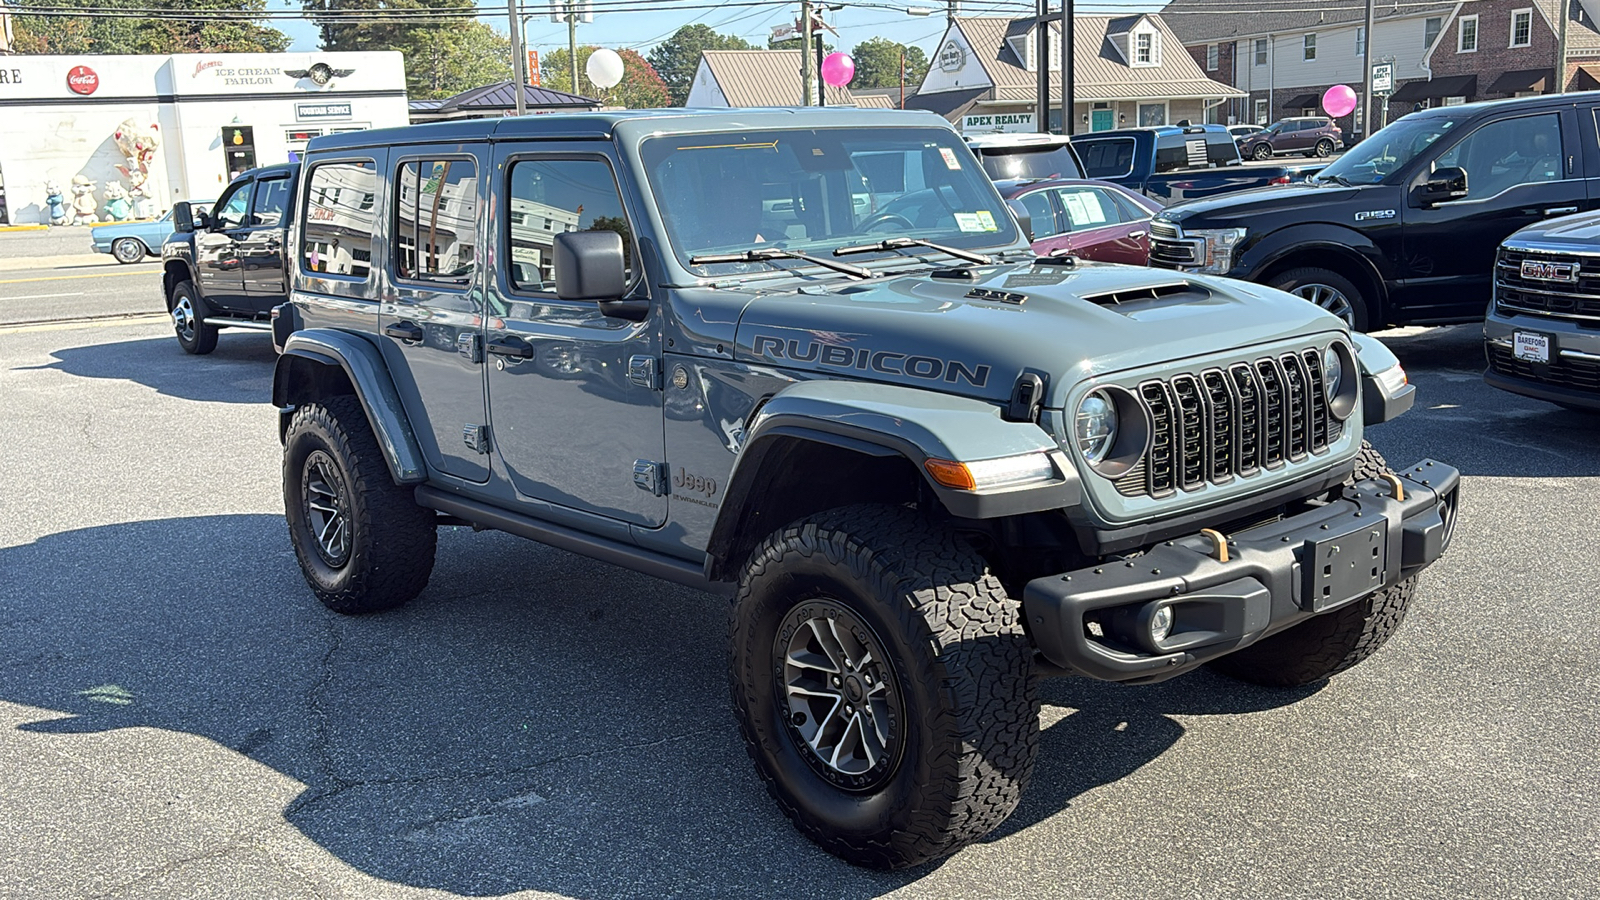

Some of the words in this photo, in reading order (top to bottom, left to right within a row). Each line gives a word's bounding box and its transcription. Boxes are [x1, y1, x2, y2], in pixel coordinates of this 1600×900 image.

[238, 68, 281, 76] CREAM
[530, 52, 538, 82] ACME
[300, 106, 327, 115] FOUNTAIN
[327, 105, 350, 114] SERVICE
[967, 116, 992, 126] APEX
[995, 115, 1031, 125] REALTY
[1522, 264, 1571, 279] GMC
[1517, 336, 1546, 347] BAREFORD
[752, 335, 992, 388] RUBICON
[673, 466, 717, 498] Jeep
[680, 496, 719, 510] WRANGLER
